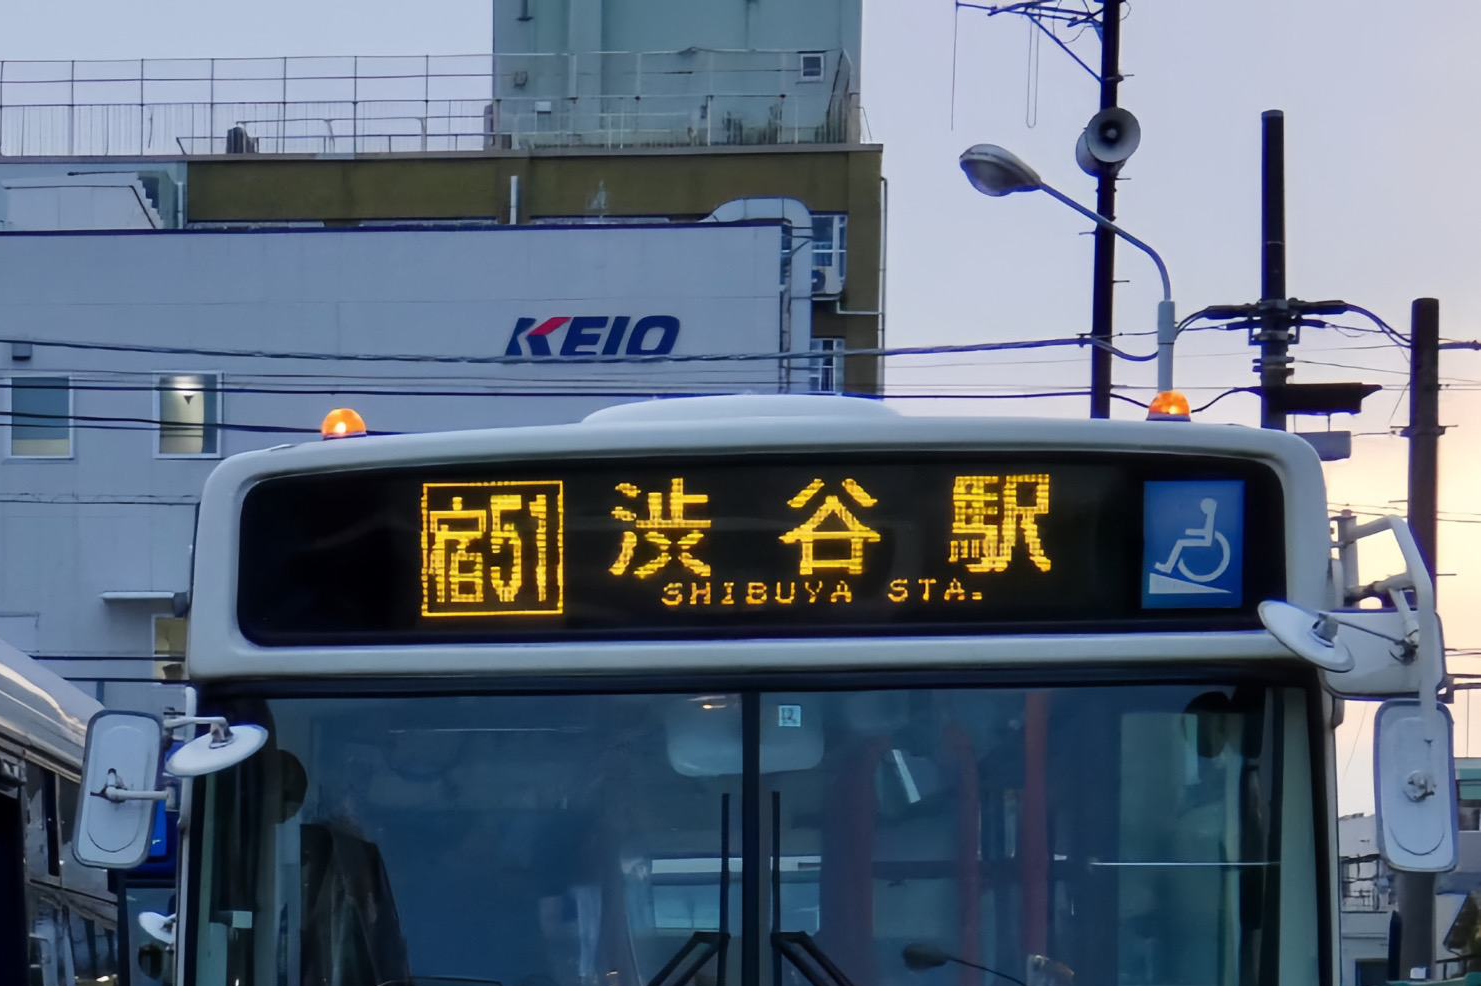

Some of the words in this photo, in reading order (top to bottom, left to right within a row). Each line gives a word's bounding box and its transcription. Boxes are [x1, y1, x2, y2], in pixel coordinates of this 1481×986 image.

[505, 315, 680, 356] KEIO
[661, 578, 853, 606] SHIBUYA
[887, 577, 984, 603] STA.
